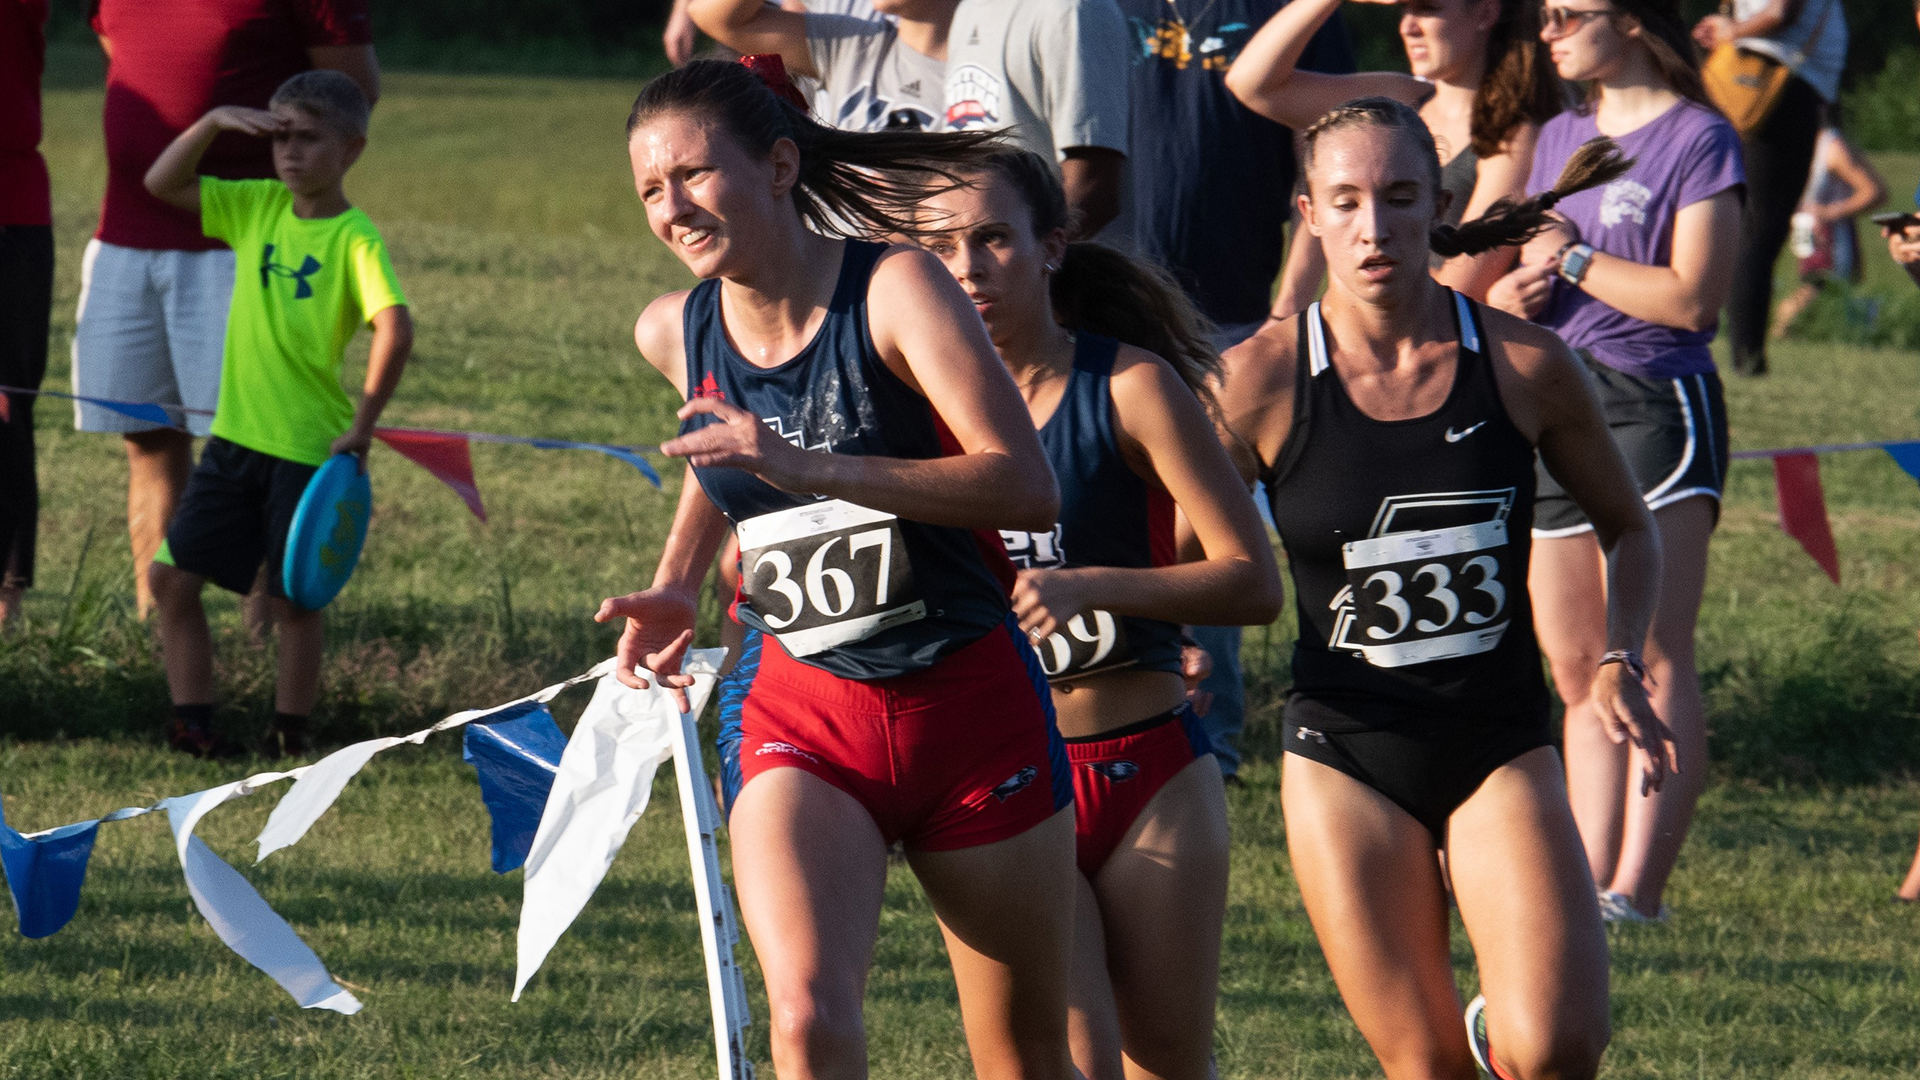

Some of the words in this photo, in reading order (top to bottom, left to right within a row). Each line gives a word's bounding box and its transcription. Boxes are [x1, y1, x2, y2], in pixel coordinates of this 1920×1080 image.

[753, 527, 892, 629] 367
[1361, 554, 1507, 640] 333
[1031, 609, 1117, 676] 69
